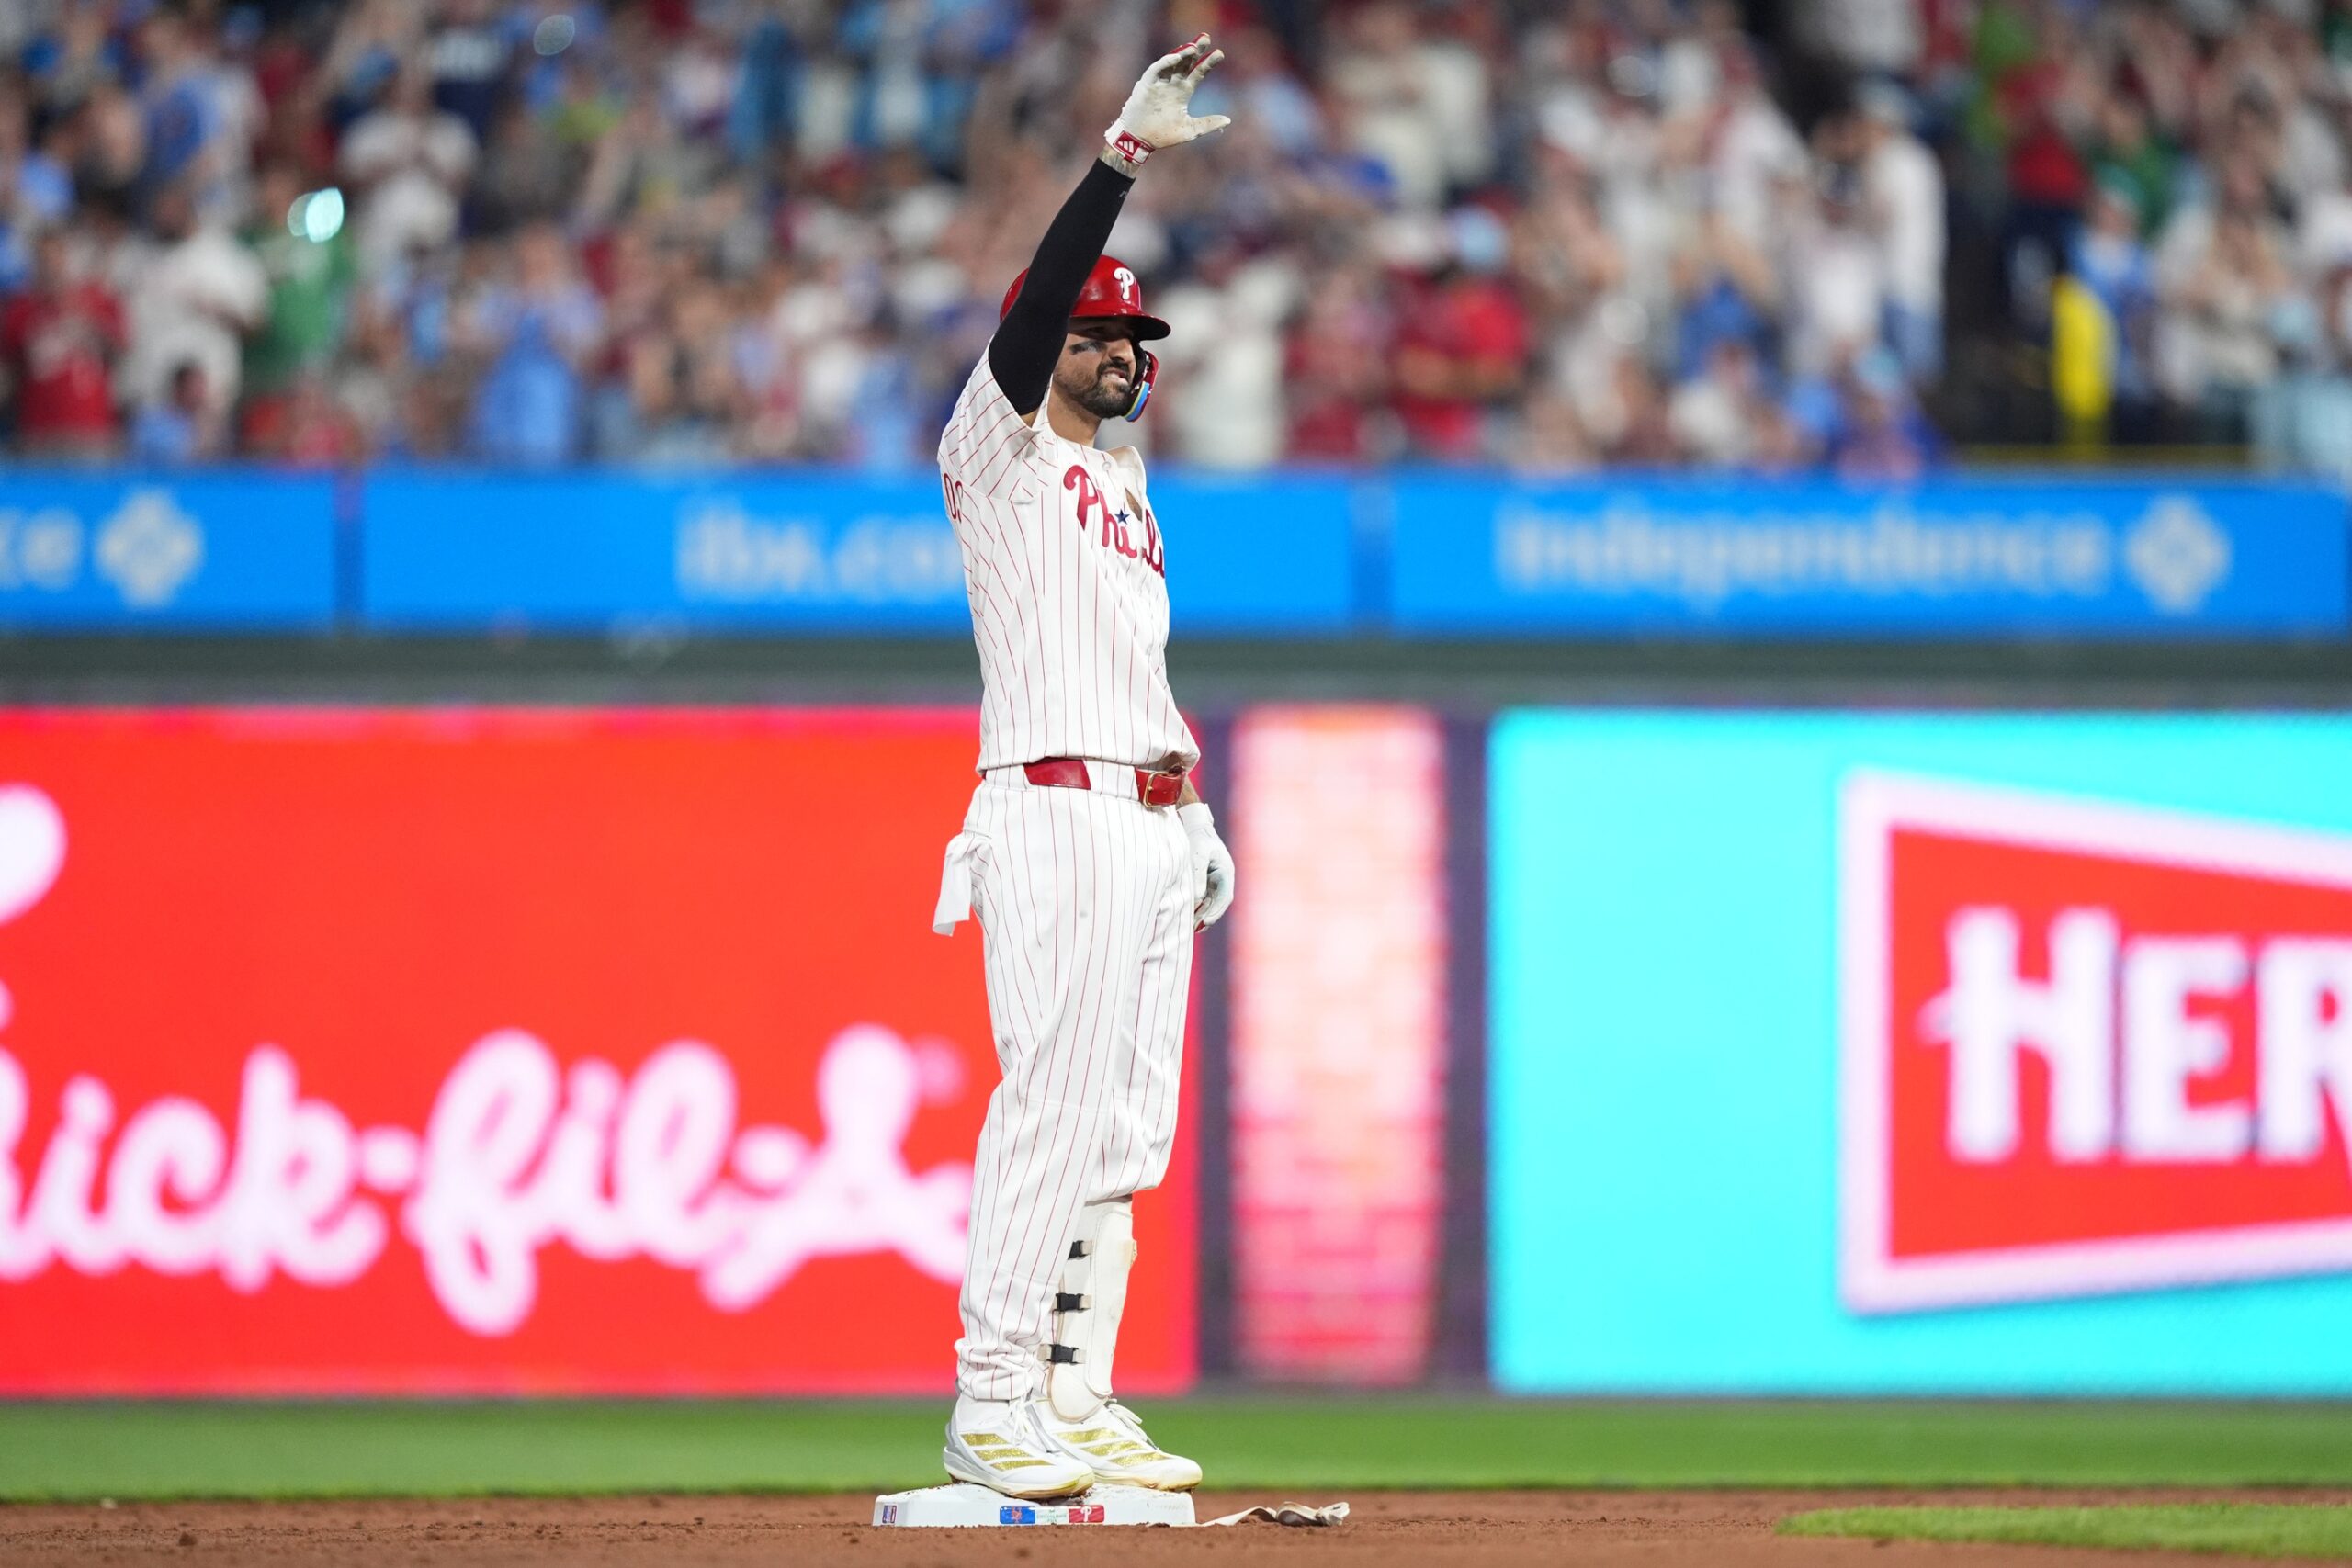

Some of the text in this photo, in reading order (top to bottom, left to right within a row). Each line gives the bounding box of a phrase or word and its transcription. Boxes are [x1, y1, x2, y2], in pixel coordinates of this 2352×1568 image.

[1114, 267, 1135, 300] P
[674, 499, 964, 603] ibx.co
[1916, 904, 2352, 1163] HER
